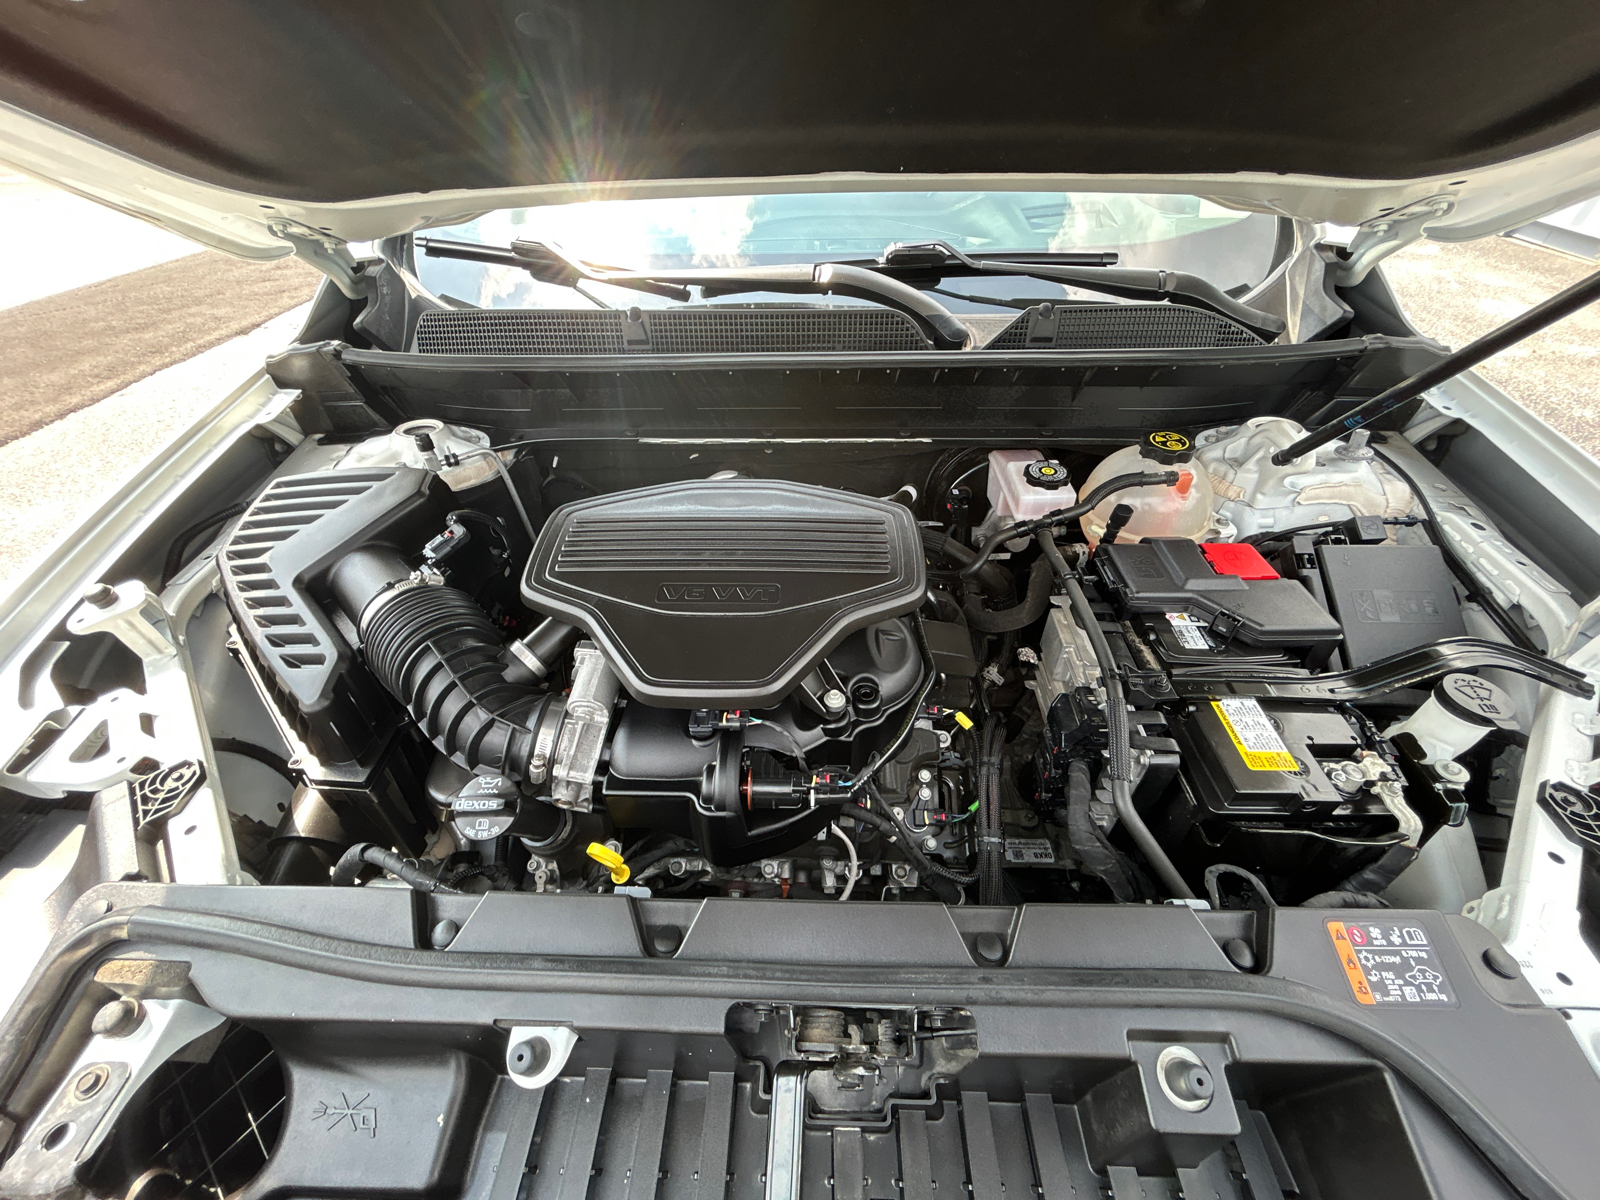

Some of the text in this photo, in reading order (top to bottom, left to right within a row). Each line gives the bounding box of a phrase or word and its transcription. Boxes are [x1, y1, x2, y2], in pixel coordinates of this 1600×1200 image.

[663, 586, 776, 600] V6 VVT
[455, 798, 498, 809] dexos
[464, 825, 500, 838] SAE 5W-30
